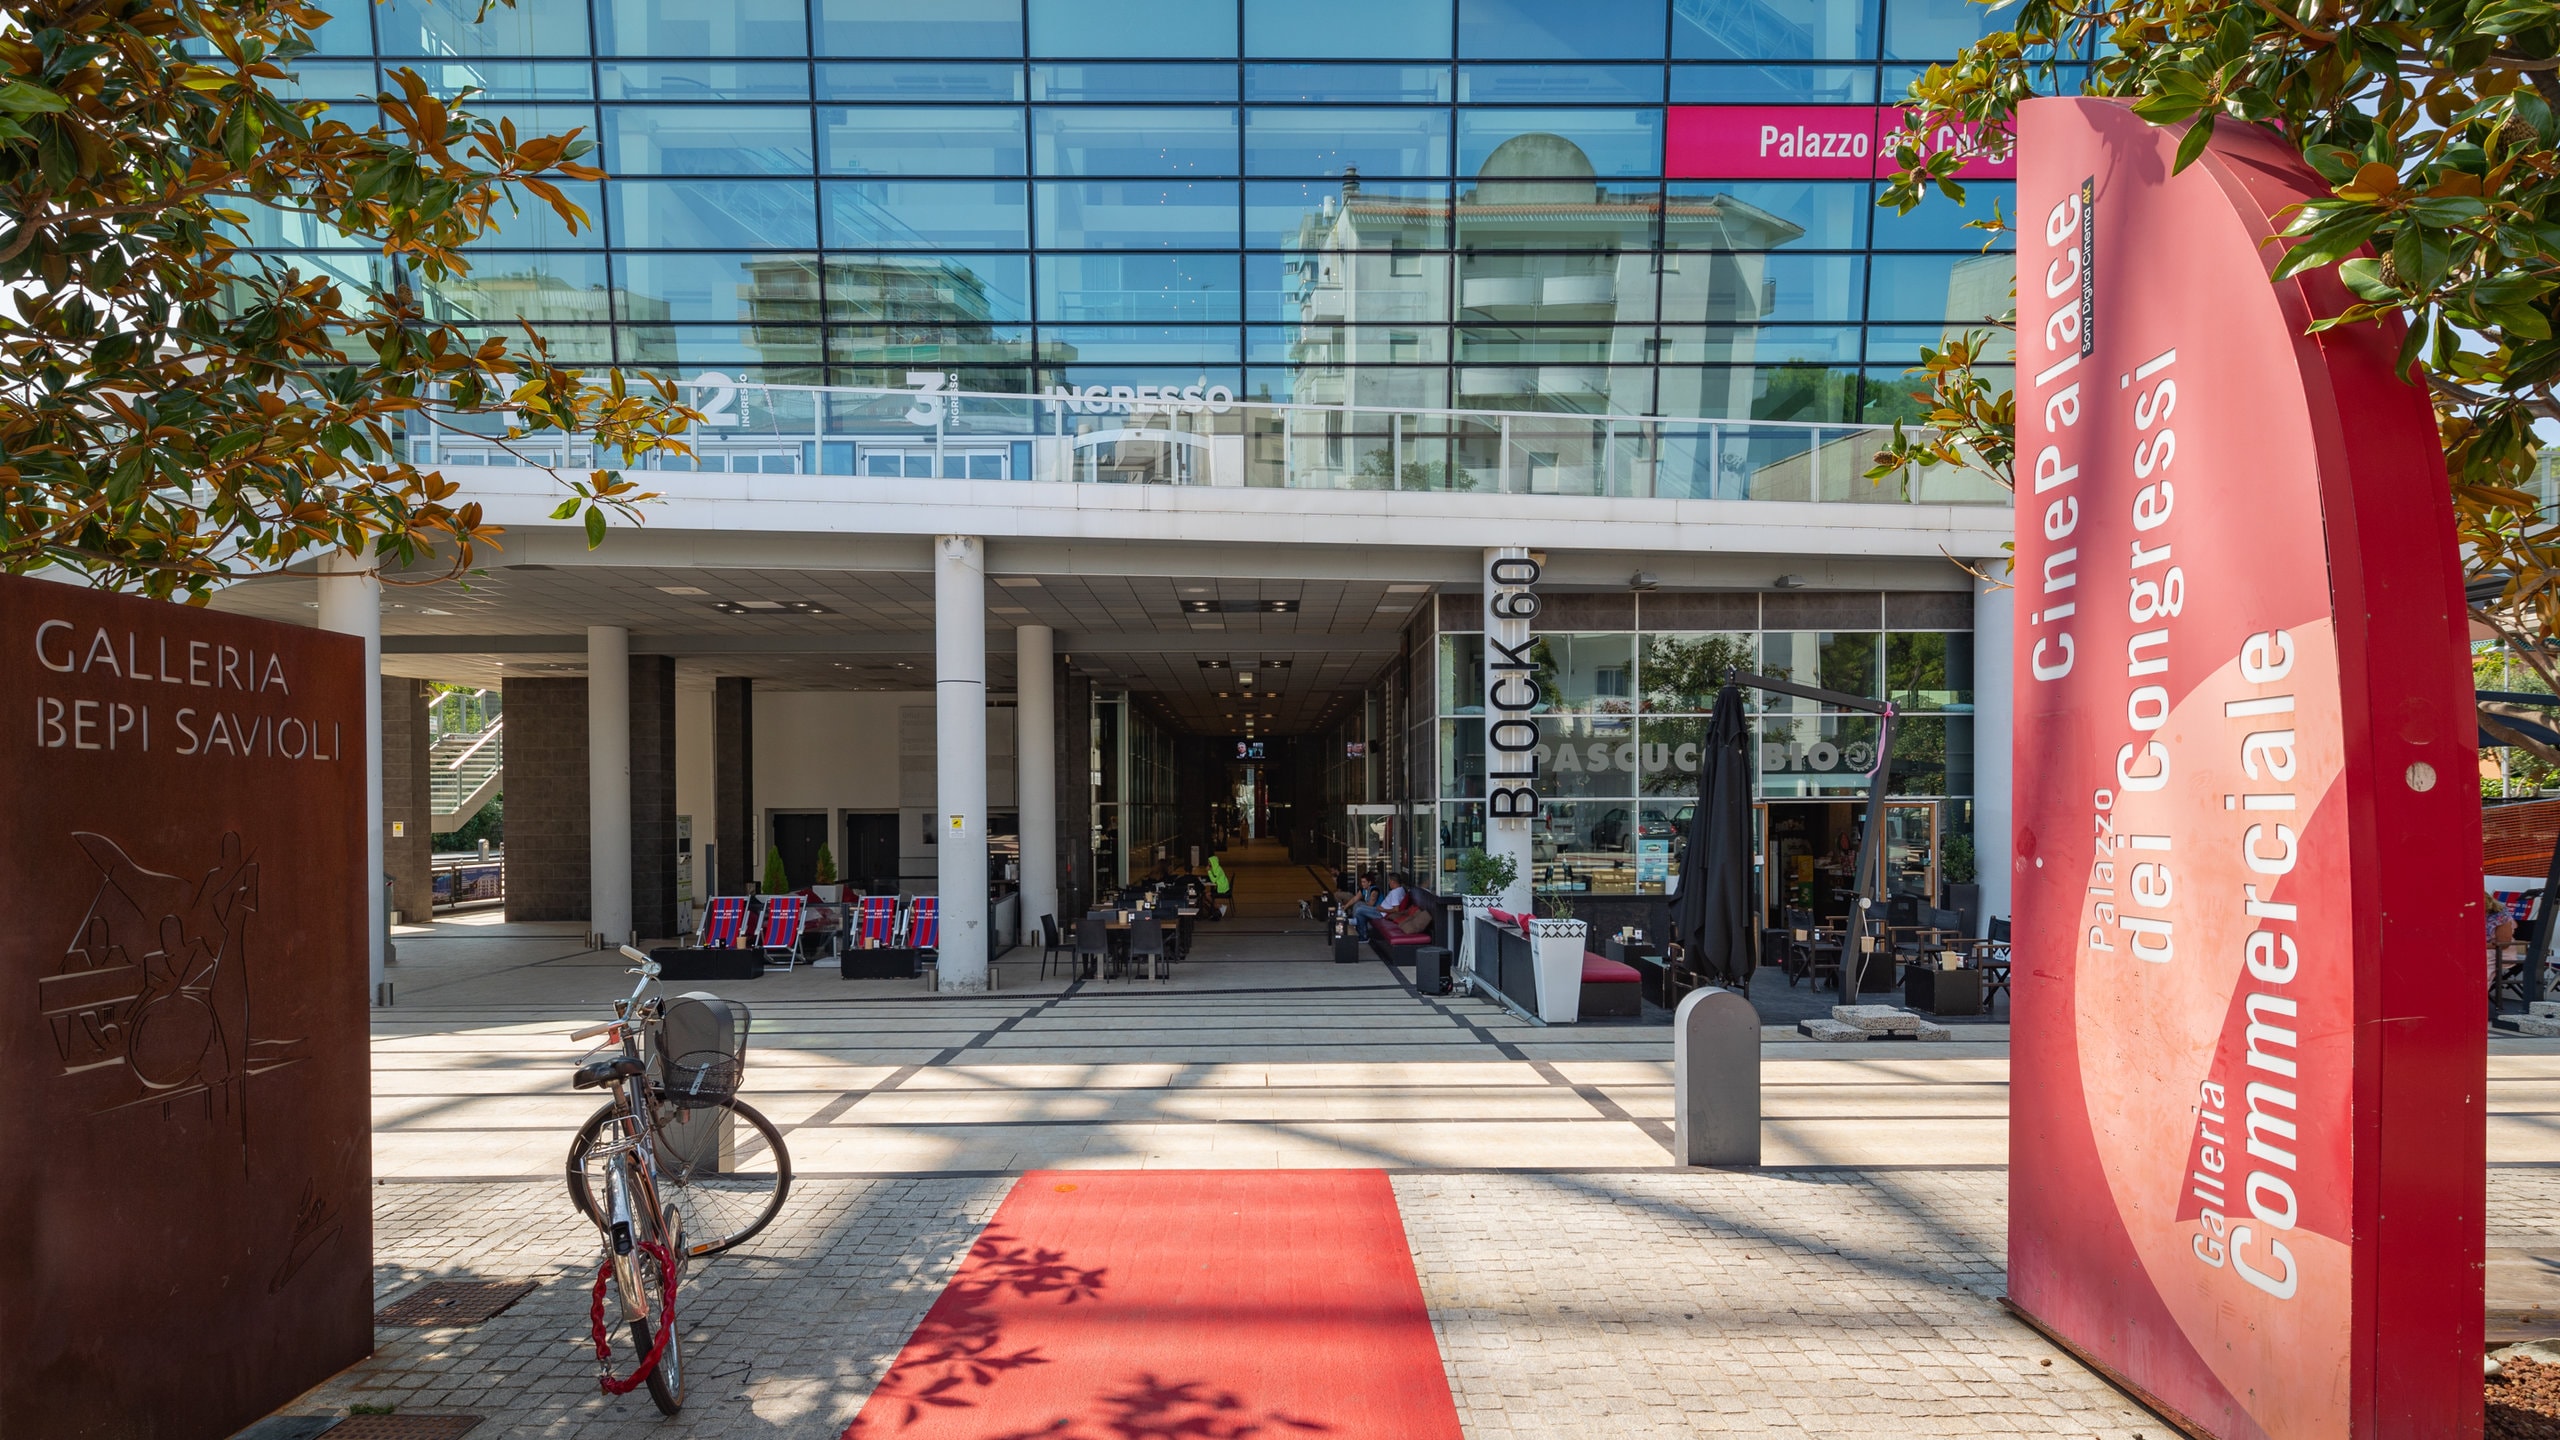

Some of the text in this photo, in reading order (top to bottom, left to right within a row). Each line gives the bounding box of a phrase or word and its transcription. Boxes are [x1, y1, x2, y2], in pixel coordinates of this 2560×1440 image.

[1760, 126, 1868, 158] Palazzo
[2082, 183, 2093, 352] Sony Digital Cinema 4K
[695, 371, 738, 427] 2
[739, 374, 750, 427] INGRESO
[904, 372, 946, 426] 3
[1044, 385, 1234, 414] INGRESSO
[2032, 192, 2081, 682] CinePalace
[35, 619, 291, 695] GALLERIA
[1490, 558, 1542, 818] BLOCK 60
[2116, 347, 2184, 963] dei Congressi
[37, 696, 341, 761] BEPI SAVIOLI
[1533, 742, 1840, 772] PASCUC BIO
[2089, 788, 2115, 953] Palazzo
[2224, 629, 2299, 1300] Commerciale
[2191, 1079, 2227, 1268] Galleria
